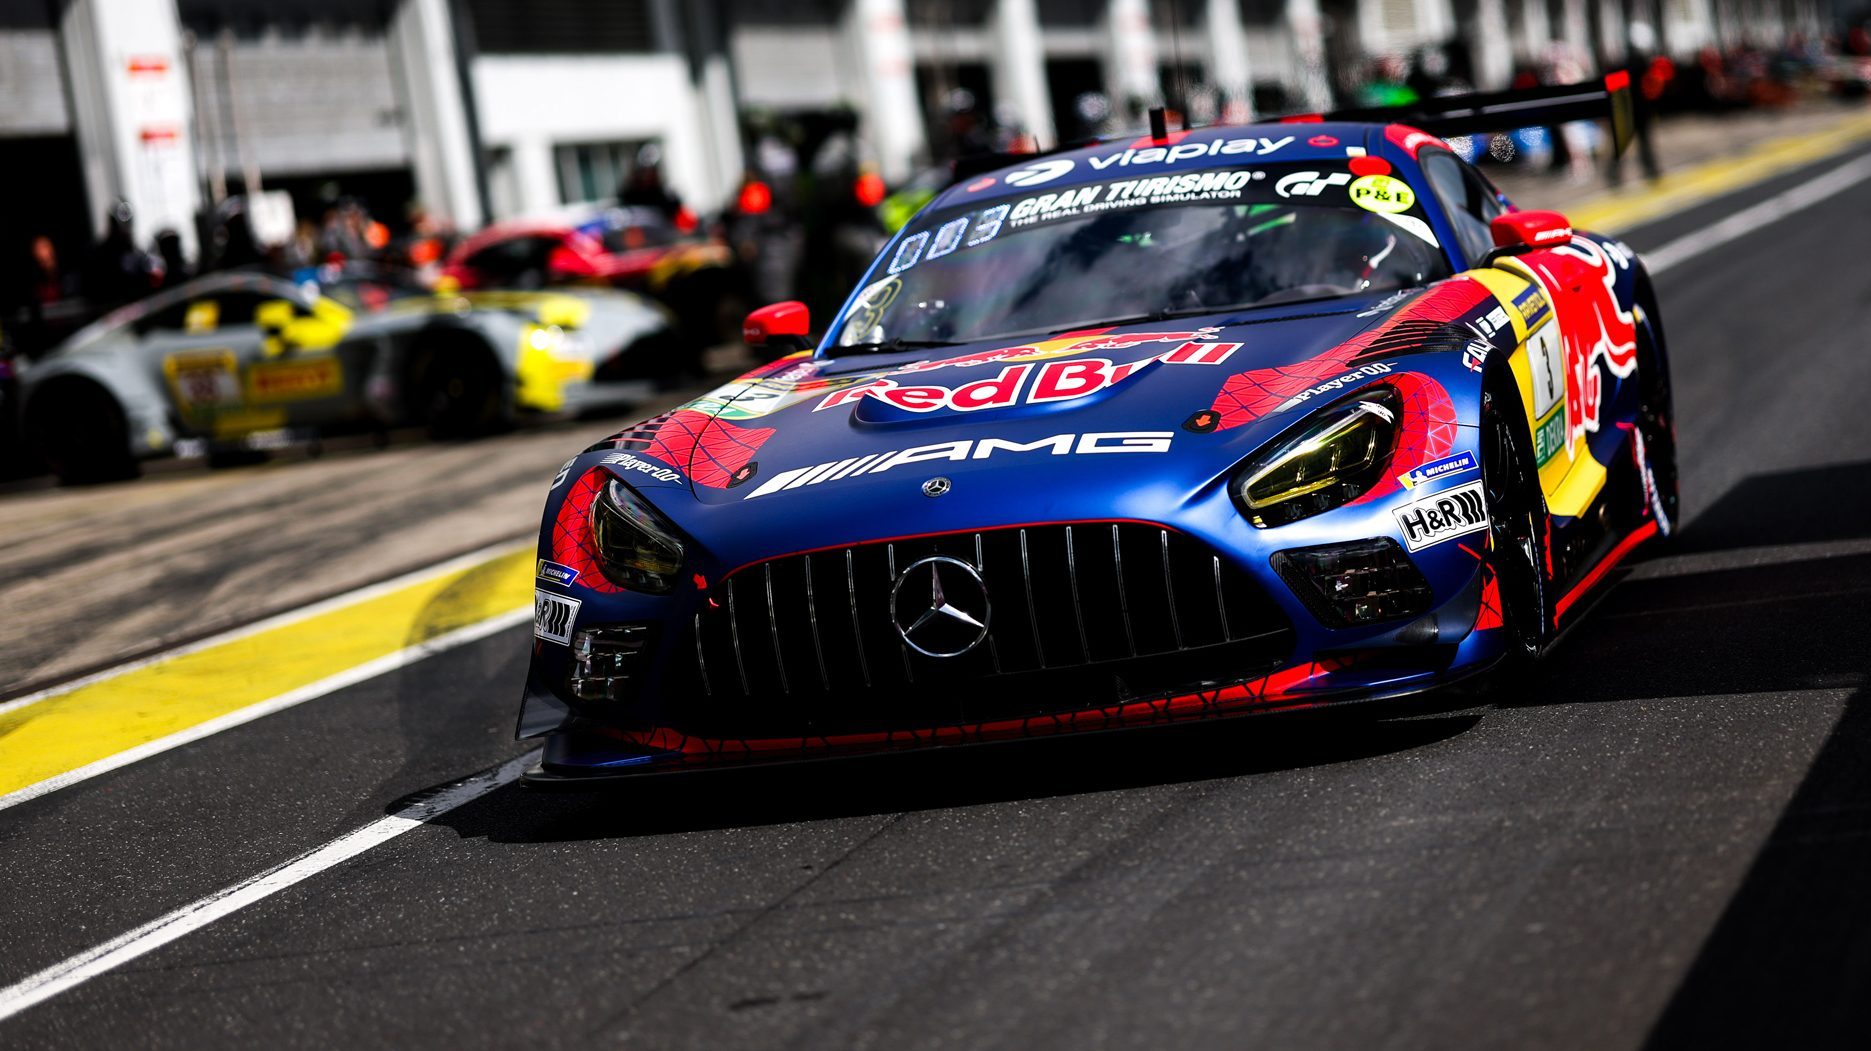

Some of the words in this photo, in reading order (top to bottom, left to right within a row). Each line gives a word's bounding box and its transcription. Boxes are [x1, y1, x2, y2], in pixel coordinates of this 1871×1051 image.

[1088, 135, 1296, 171] viaplay
[1010, 184, 1103, 221] GRAN
[1010, 216, 1038, 228] THE
[1040, 207, 1079, 222] REAL
[1082, 197, 1147, 214] DRIVING
[1150, 189, 1242, 204] SIMULATOR
[811, 362, 1036, 412] Red
[1426, 457, 1470, 477] MICHELIN
[1402, 500, 1463, 540] H&R
[546, 567, 571, 580] MICHELIN
